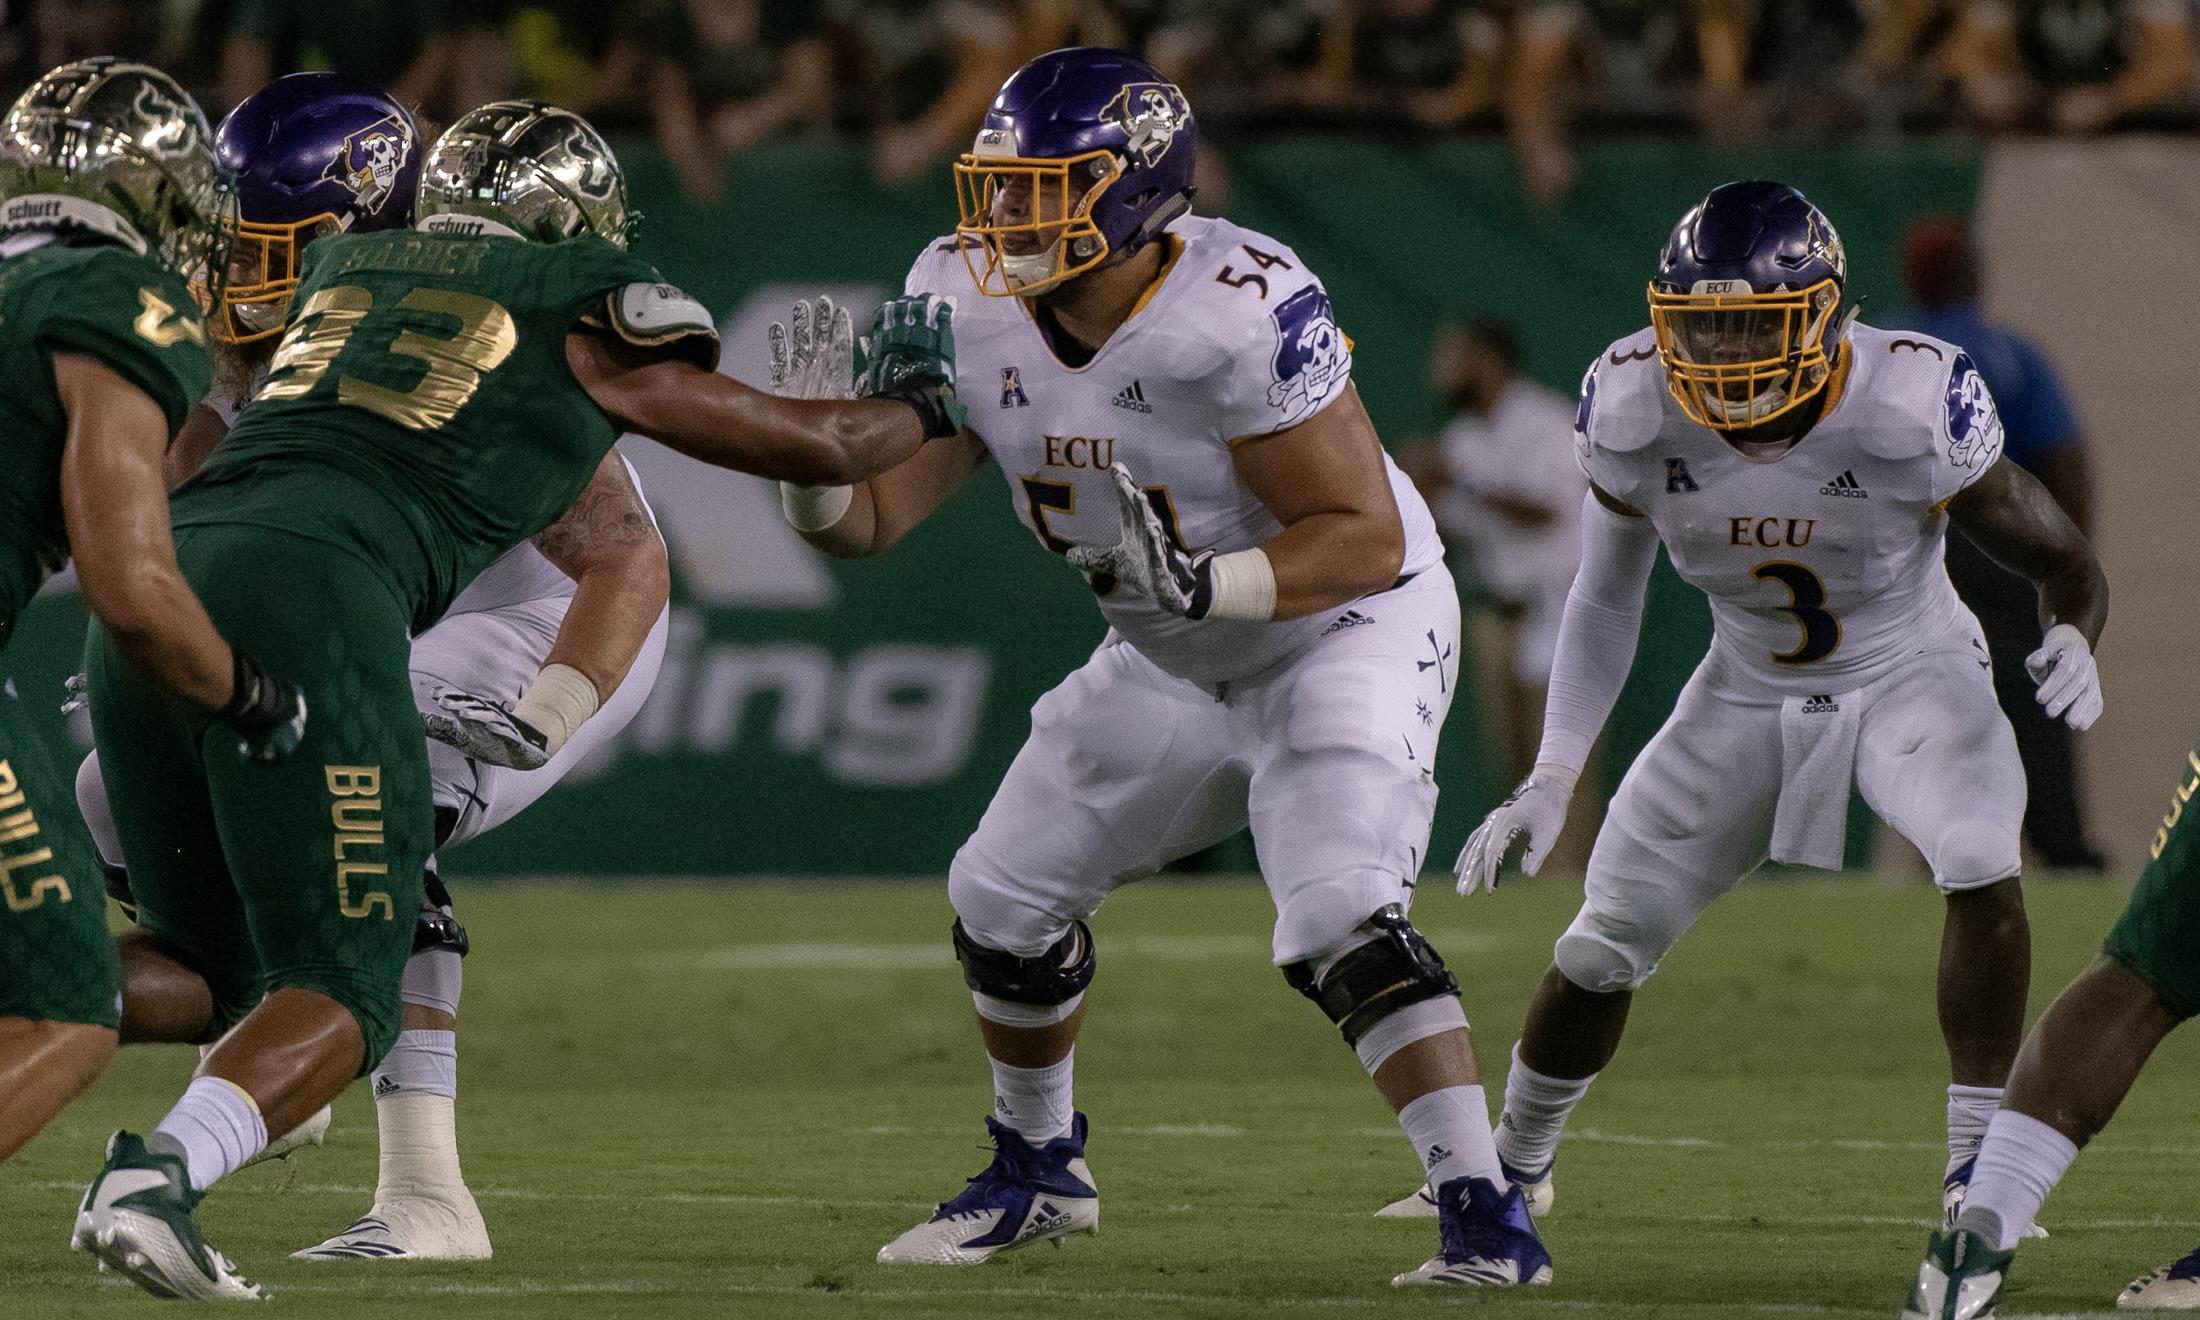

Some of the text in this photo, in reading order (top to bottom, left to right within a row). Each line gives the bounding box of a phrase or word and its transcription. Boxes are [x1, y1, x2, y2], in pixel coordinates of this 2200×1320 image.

[8, 200, 62, 221] schutt
[428, 217, 484, 232] schutt
[1215, 243, 1293, 300] 54
[1706, 282, 1733, 294] ECU
[1888, 338, 1943, 362] 3
[1111, 397, 1153, 414] adidas
[1043, 434, 1116, 471] ECU
[1820, 485, 1868, 499] adidas
[1728, 516, 1817, 548] ECU
[1748, 559, 1844, 667] 3
[632, 607, 992, 785] ing
[325, 765, 394, 921] BULLS
